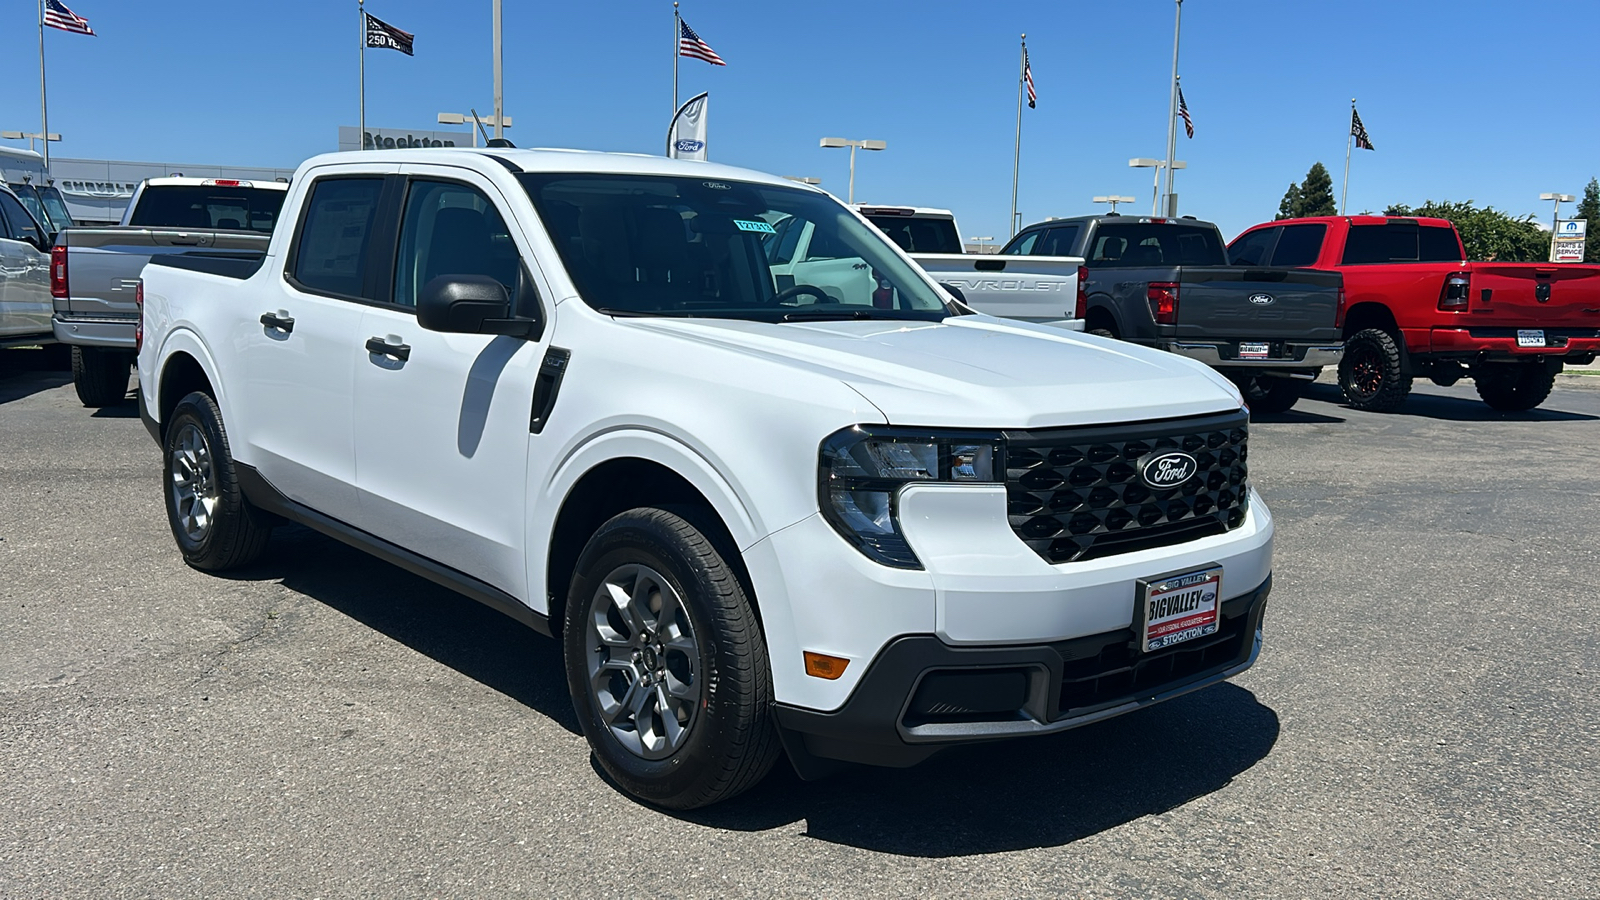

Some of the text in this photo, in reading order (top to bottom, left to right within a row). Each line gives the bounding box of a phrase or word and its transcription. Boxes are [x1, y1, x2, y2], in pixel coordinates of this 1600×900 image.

[368, 35, 385, 45] 250
[360, 131, 455, 150] Stockton
[677, 141, 700, 151] Ford
[737, 221, 774, 231] T27313
[940, 279, 1066, 292] EVROLET
[1154, 457, 1189, 482] Ford
[1167, 573, 1206, 589] BIG VALLEY
[1149, 590, 1203, 621] BIGVALLEY
[1162, 626, 1203, 645] STOCKTON
